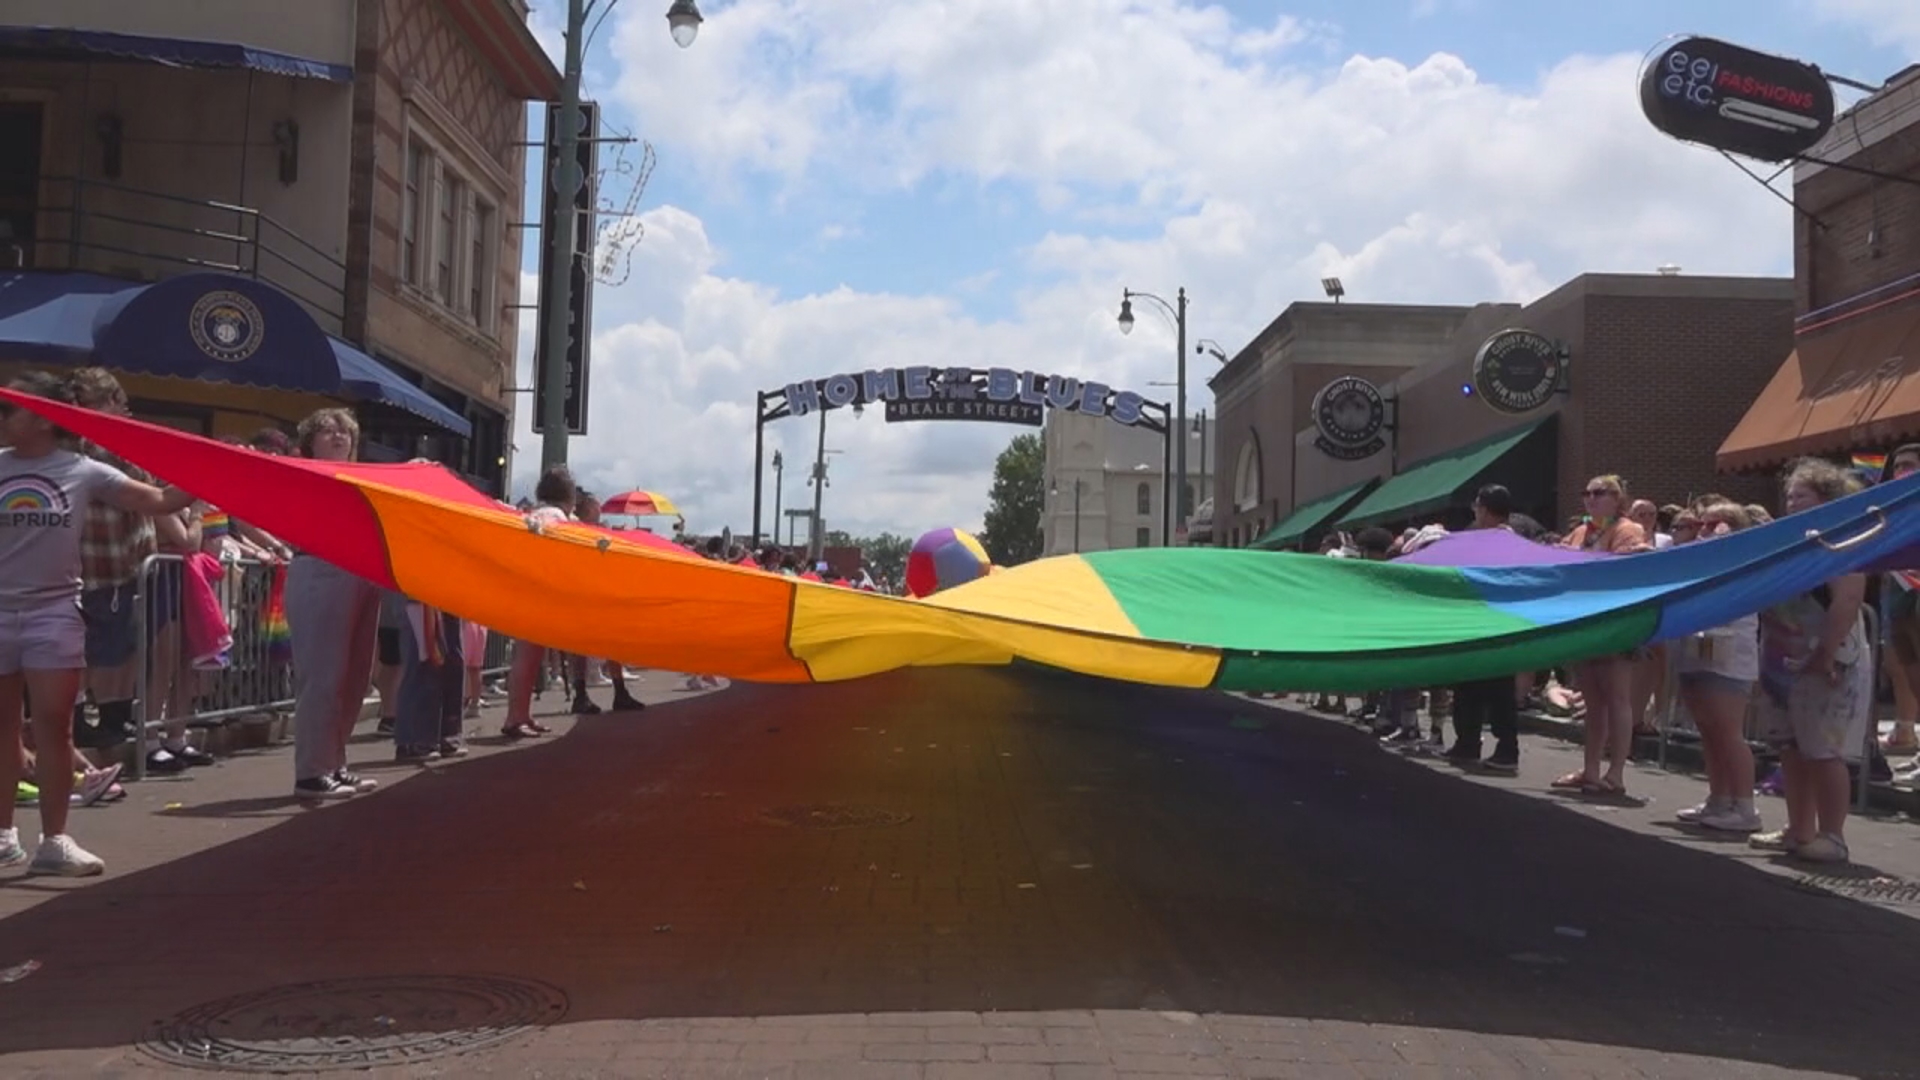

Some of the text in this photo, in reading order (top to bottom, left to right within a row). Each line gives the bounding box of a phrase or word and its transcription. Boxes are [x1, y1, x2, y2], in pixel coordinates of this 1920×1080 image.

[1663, 74, 1717, 105] etc.
[1718, 69, 1814, 109] FASHIONS
[1491, 335, 1551, 356] GHOST RIVER
[785, 365, 932, 416] HOME
[938, 383, 977, 399] THE
[986, 367, 1145, 425] BLUES
[1327, 382, 1378, 402] GHOST RIVER
[899, 402, 1030, 419] BEALE STREET
[13, 513, 73, 528] PRIDE
